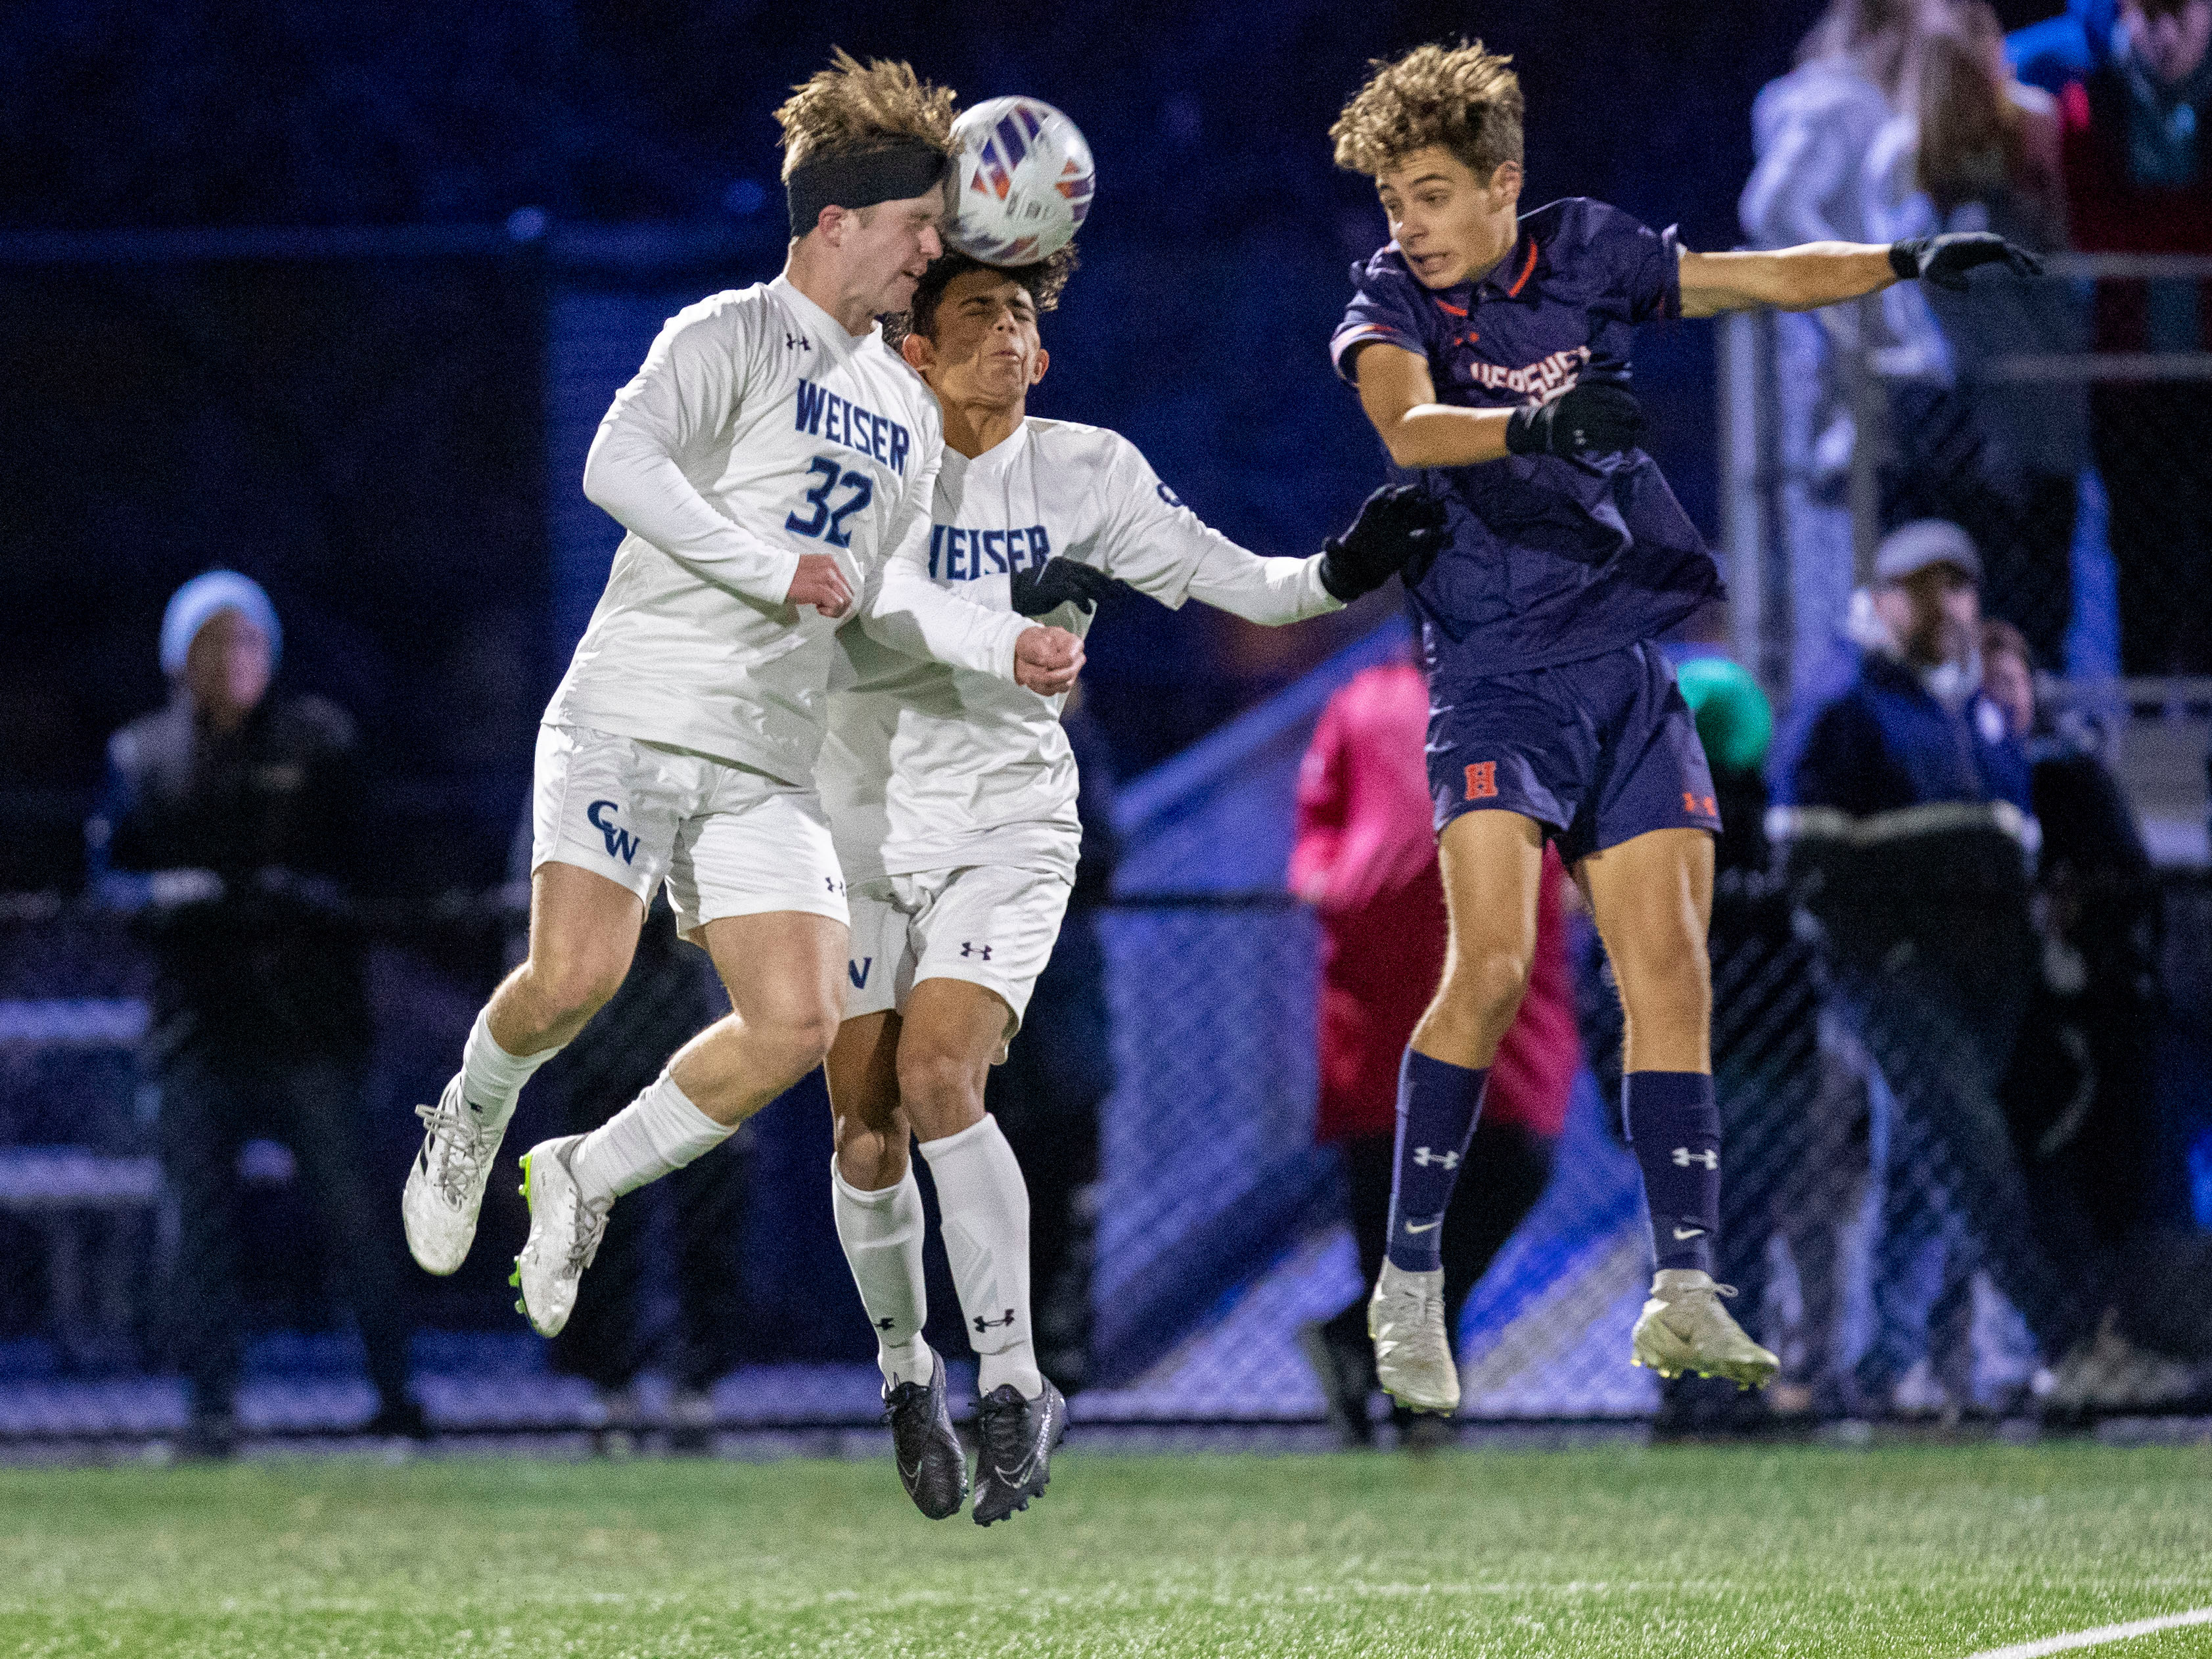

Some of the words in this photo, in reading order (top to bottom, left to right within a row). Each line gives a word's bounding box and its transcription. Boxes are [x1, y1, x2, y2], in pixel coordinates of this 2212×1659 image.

[794, 378, 910, 476] WEISER
[785, 457, 873, 549] 32
[1465, 761, 1498, 801] H
[587, 800, 641, 865] CW
